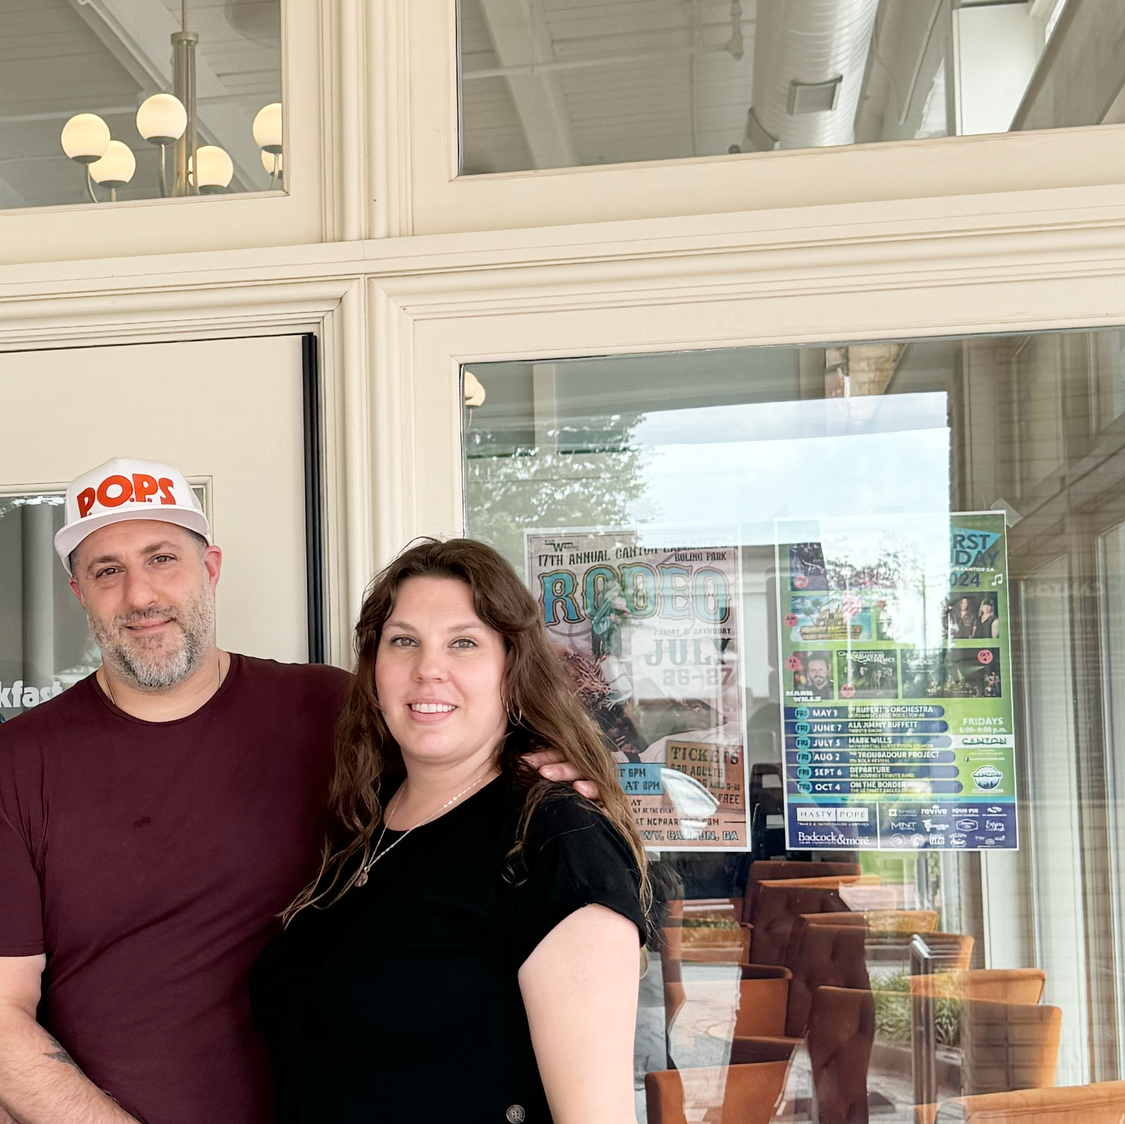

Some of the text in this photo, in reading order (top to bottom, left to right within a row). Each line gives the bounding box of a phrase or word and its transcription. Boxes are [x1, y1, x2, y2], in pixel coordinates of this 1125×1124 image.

[952, 533, 991, 550] RST
[538, 554, 564, 567] 17TH
[569, 550, 611, 565] ANNUAL
[674, 551, 727, 563] BOLING PARK
[950, 572, 981, 587] 024
[538, 562, 733, 627] RODEO
[643, 637, 732, 667] JULY
[662, 668, 733, 686] 26-27
[963, 717, 1003, 726] FRIDAYS
[812, 724, 835, 732] JUNE
[813, 739, 833, 747] JULY
[625, 781, 640, 790] AT
[718, 794, 740, 804] FREE
[640, 830, 739, 841] WY. CAON, GA
[798, 831, 836, 842] Badcock
